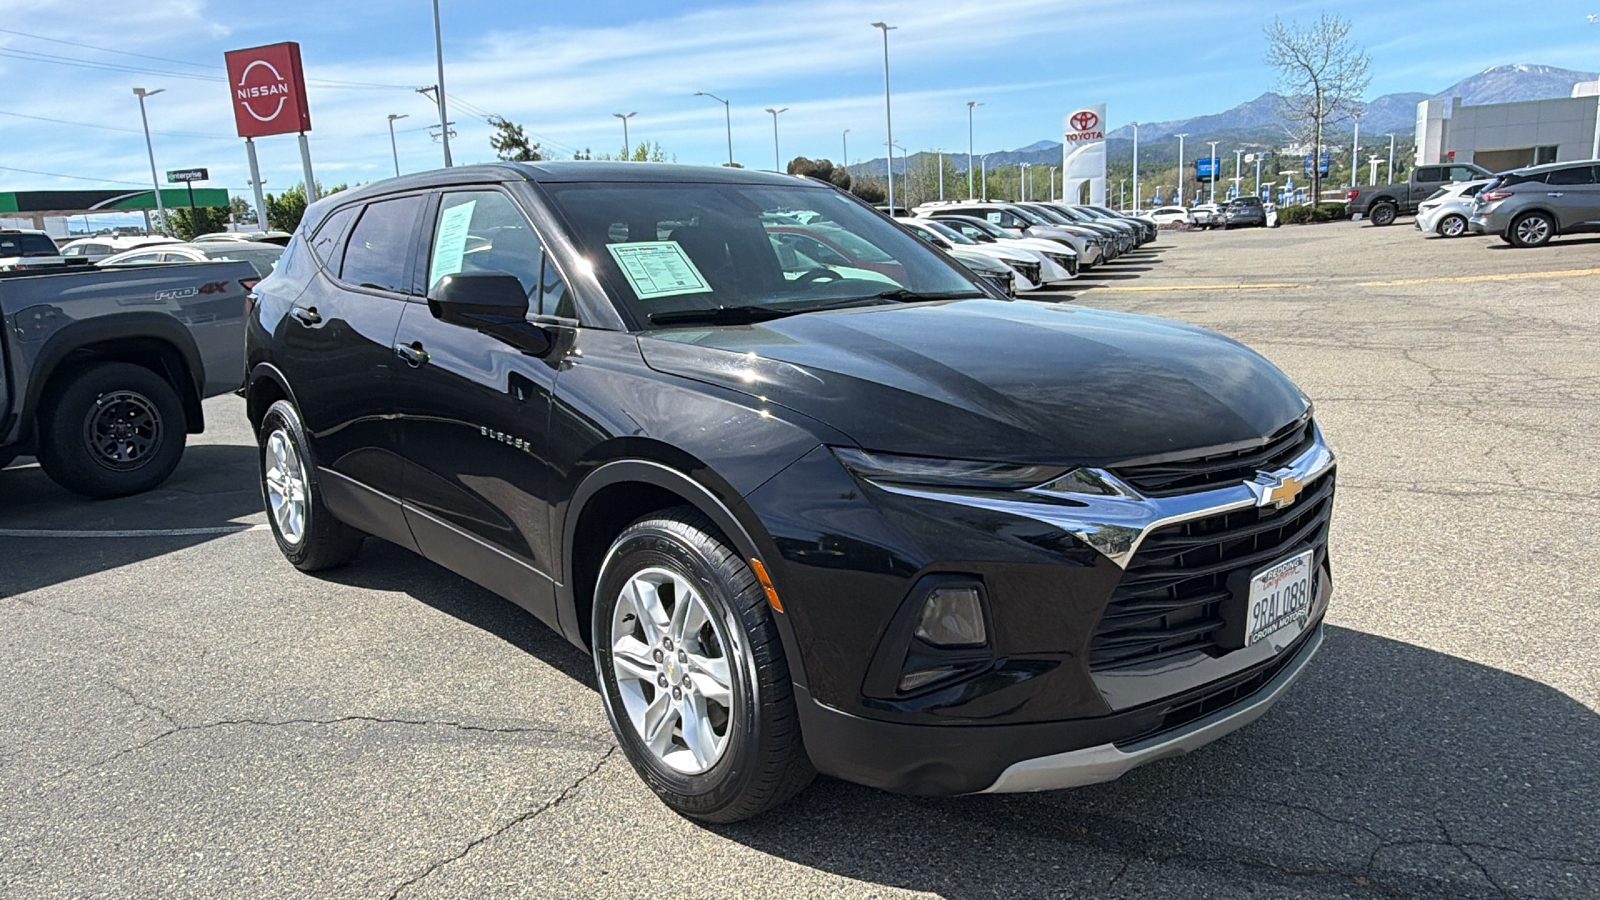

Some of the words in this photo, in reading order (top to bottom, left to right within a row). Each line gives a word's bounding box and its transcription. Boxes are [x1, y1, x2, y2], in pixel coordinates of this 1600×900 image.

[237, 83, 288, 99] NISSAN
[1065, 131, 1103, 141] TOYOTA
[480, 425, 531, 452] BLAZER
[1266, 557, 1300, 581] REDDING
[1253, 578, 1307, 634] 9RAL088
[1252, 621, 1279, 643] CROWN
[1279, 607, 1306, 629] MOTORS
